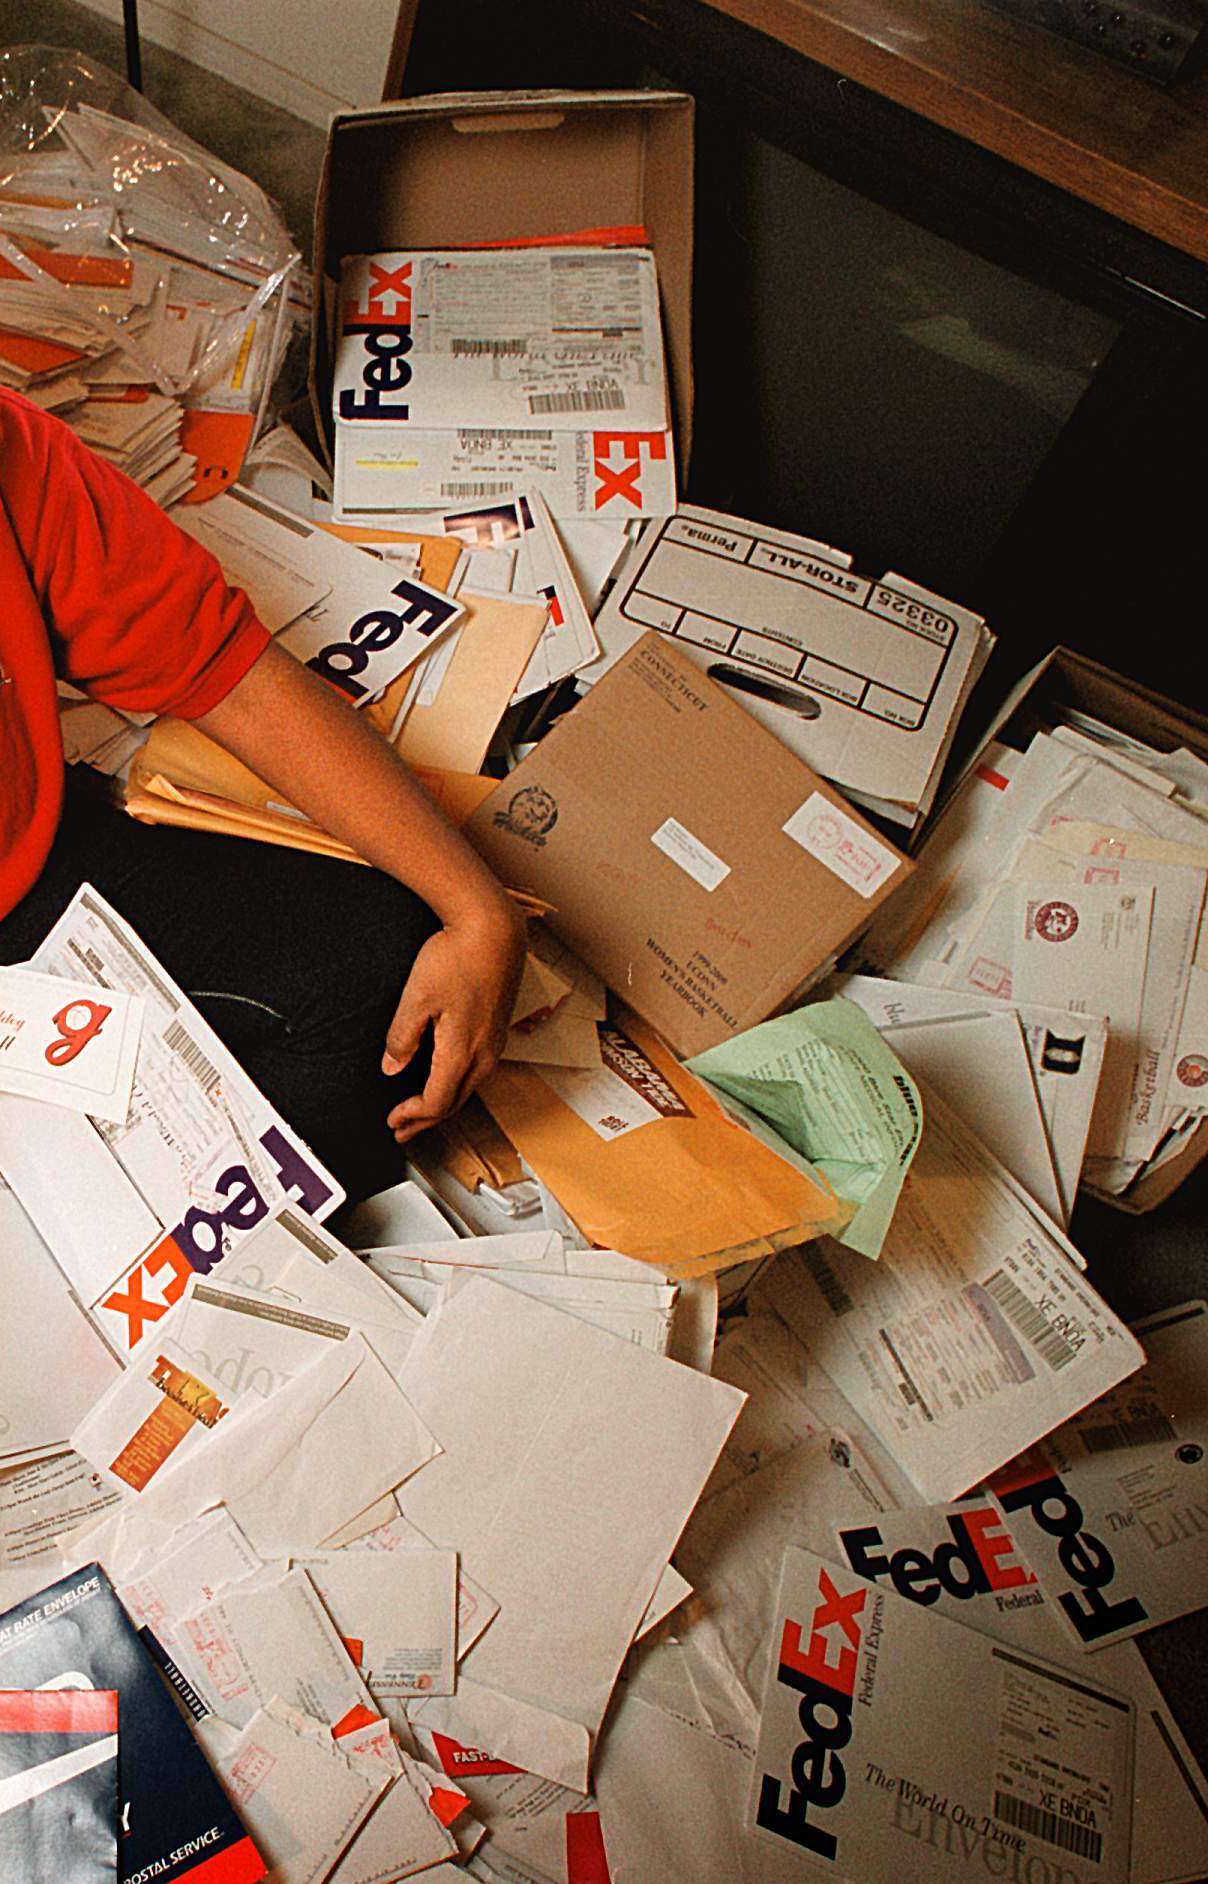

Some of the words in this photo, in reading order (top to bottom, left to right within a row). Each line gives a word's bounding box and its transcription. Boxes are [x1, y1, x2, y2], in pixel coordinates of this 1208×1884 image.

[339, 261, 413, 421] FedEx
[766, 551, 859, 594] STOR-ALL
[876, 589, 950, 632] 03325
[307, 580, 458, 703] Fed
[640, 650, 708, 712] CONNECTICUT
[646, 939, 683, 975] WOMEN'S
[683, 973, 737, 1029] BASKETBALL
[660, 973, 708, 1019] YEARBOOK
[685, 959, 718, 991] UCONN
[1136, 1051, 1161, 1124] Basketball
[102, 1125, 333, 1349] FedEx
[1105, 1511, 1135, 1532] The
[840, 1507, 1038, 1606] FedE
[13, 1609, 42, 1635] RATE
[43, 1577, 101, 1616] ENVELOPE
[865, 1593, 886, 1652] Express
[994, 1590, 1044, 1612] Federal
[858, 1652, 874, 1708] Federal
[757, 1568, 867, 1861] FedEx
[865, 1763, 898, 1786] The
[898, 1780, 946, 1818] World
[950, 1805, 976, 1826] On
[981, 1818, 1027, 1851] Time
[168, 1826, 221, 1865] SERVICE
